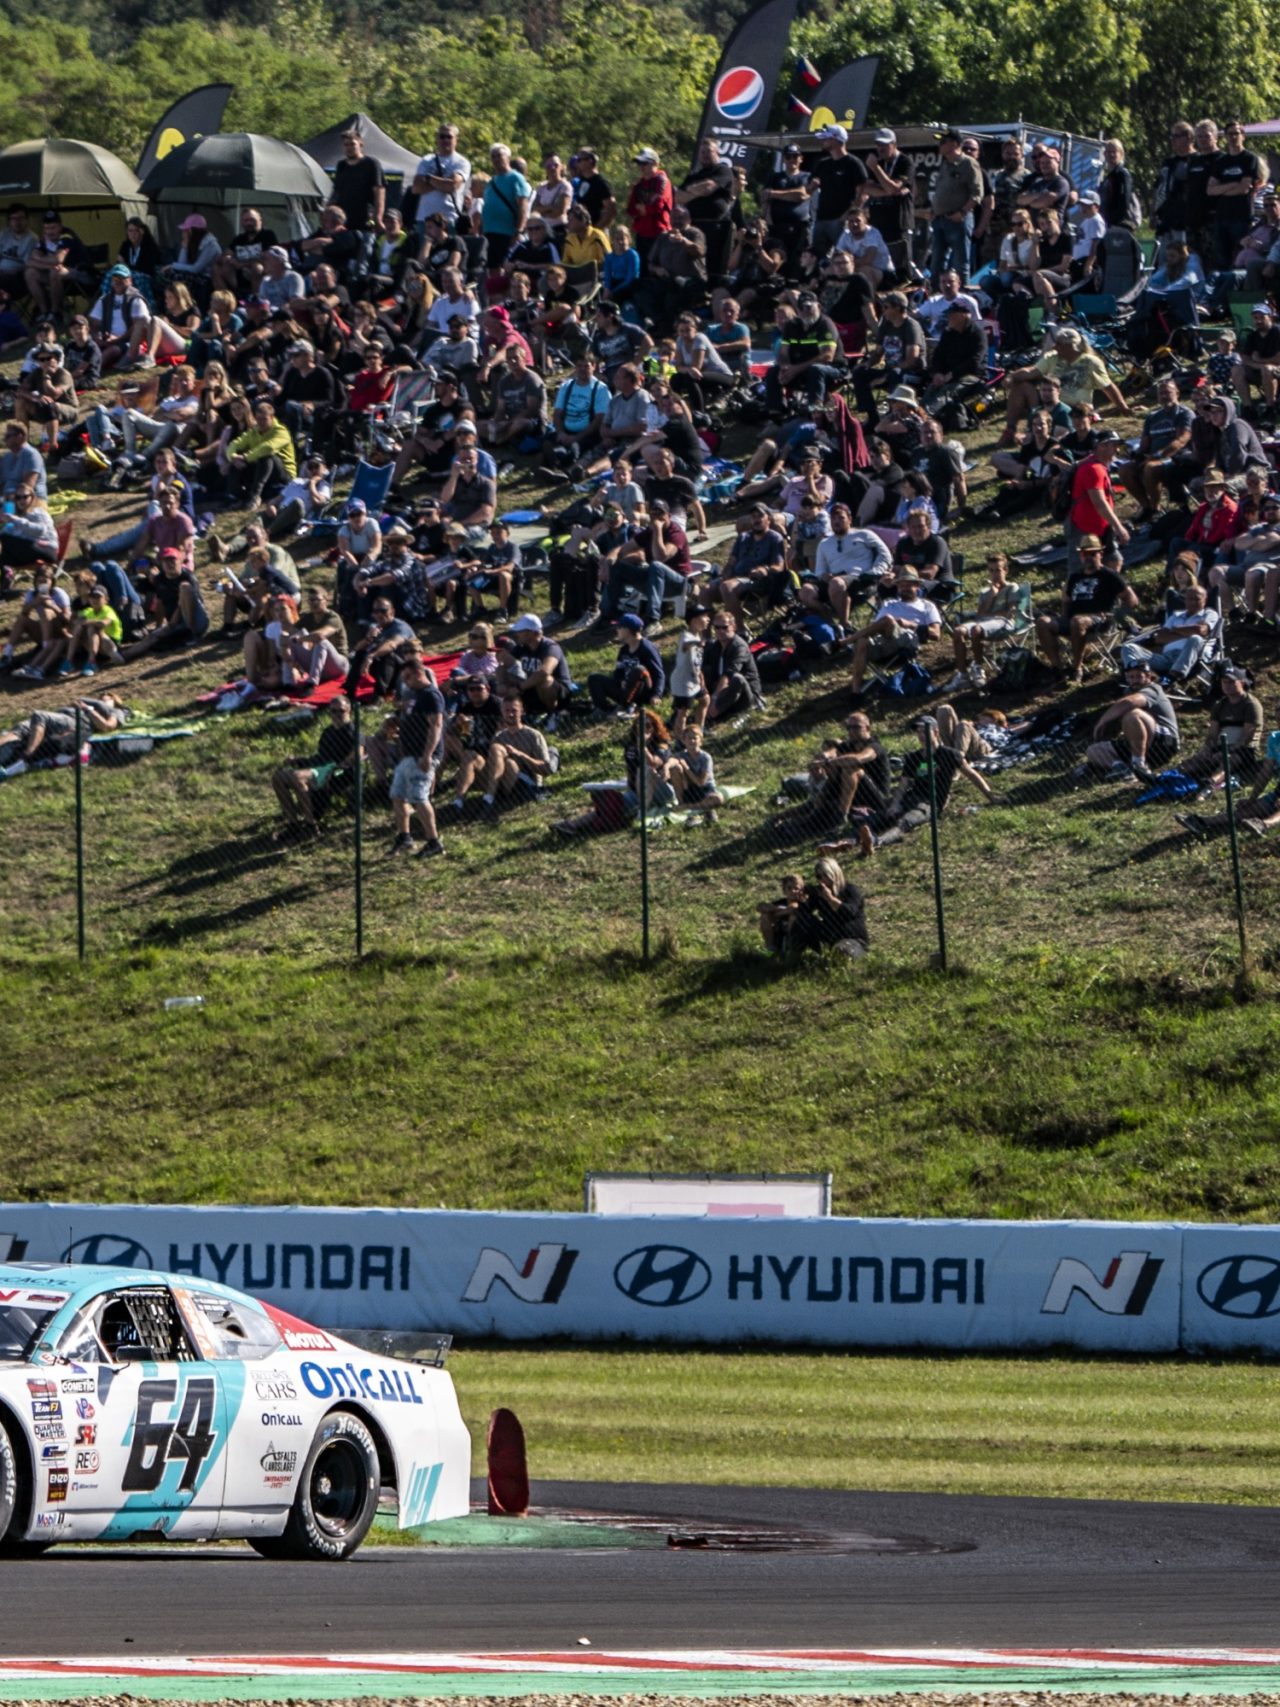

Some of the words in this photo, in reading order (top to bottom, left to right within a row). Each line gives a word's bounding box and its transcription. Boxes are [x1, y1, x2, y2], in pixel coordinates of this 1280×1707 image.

[169, 1243, 410, 1291] HYUNDAI
[729, 1255, 984, 1305] HYUNDAI
[285, 1331, 332, 1349] MOTUL
[62, 1380, 95, 1393] COMETIC
[255, 1381, 297, 1399] CARS
[35, 1423, 64, 1435] QUARTER
[121, 1378, 216, 1492] 64
[49, 1474, 68, 1483] ENZO
